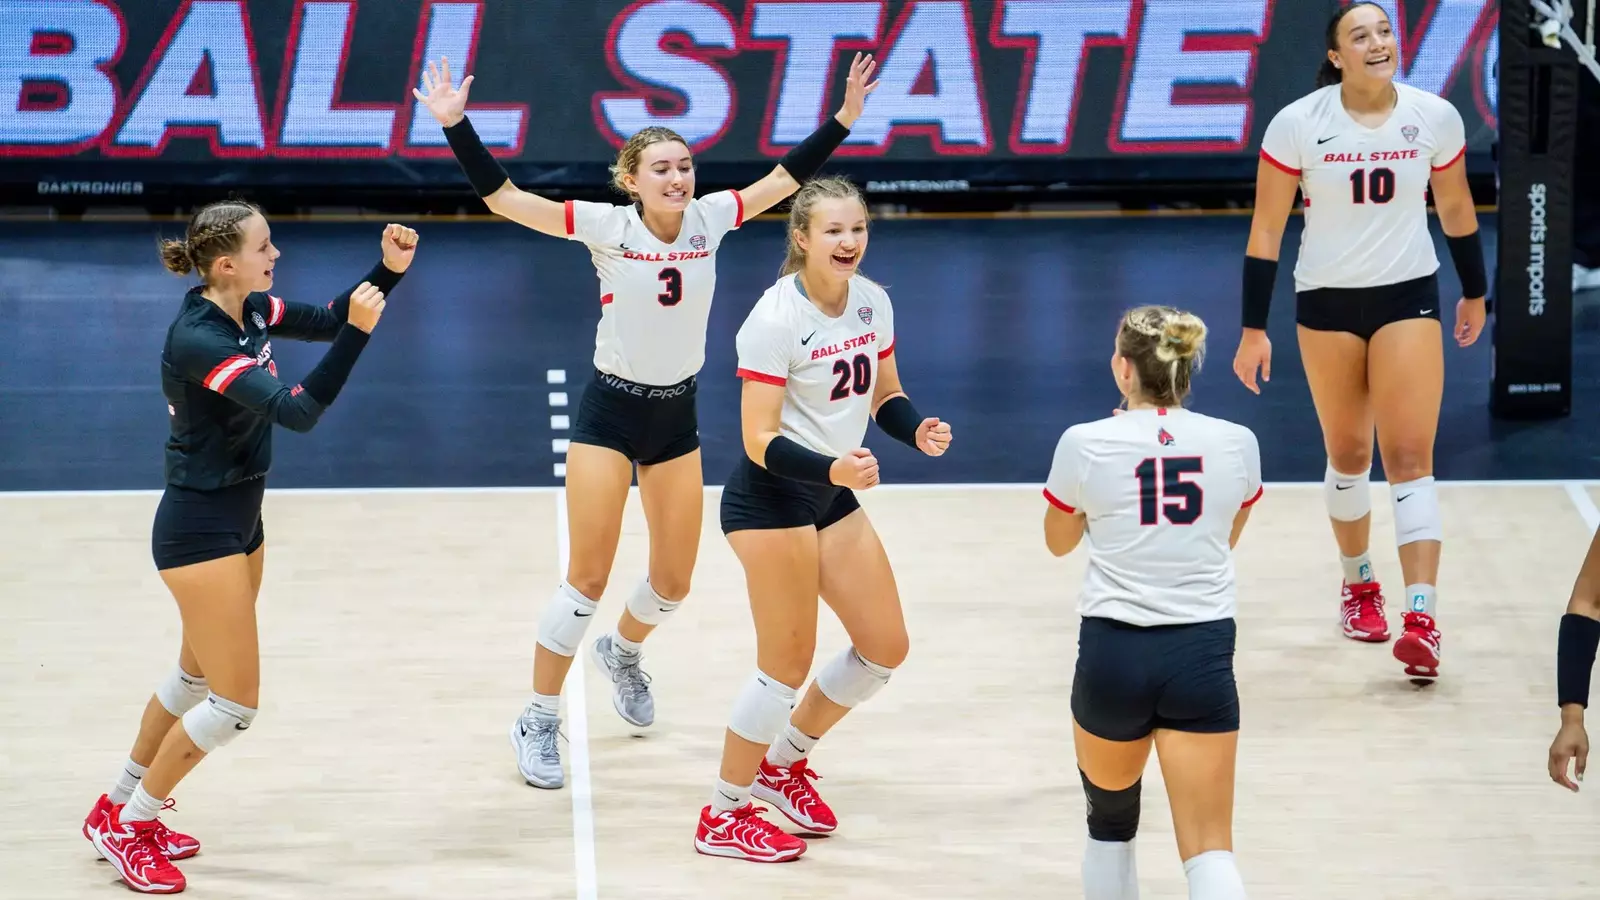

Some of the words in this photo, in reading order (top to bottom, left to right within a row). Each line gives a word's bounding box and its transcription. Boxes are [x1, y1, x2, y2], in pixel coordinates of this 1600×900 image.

[0, 0, 529, 156] BALL
[592, 0, 1271, 156] STATE
[1324, 152, 1365, 162] BALL
[1369, 149, 1419, 161] STATE
[37, 181, 143, 194] DAKTRONICS
[1350, 167, 1395, 204] 10
[1528, 184, 1547, 242] sports
[623, 251, 664, 262] BALL
[667, 251, 709, 261] STATE
[658, 267, 683, 306] 3
[1526, 244, 1545, 316] imports
[811, 344, 842, 361] BALL
[843, 332, 876, 351] STATE
[600, 374, 646, 397] NIKE
[647, 384, 687, 400] PRO
[829, 353, 872, 402] 20
[1135, 456, 1203, 526] 15
